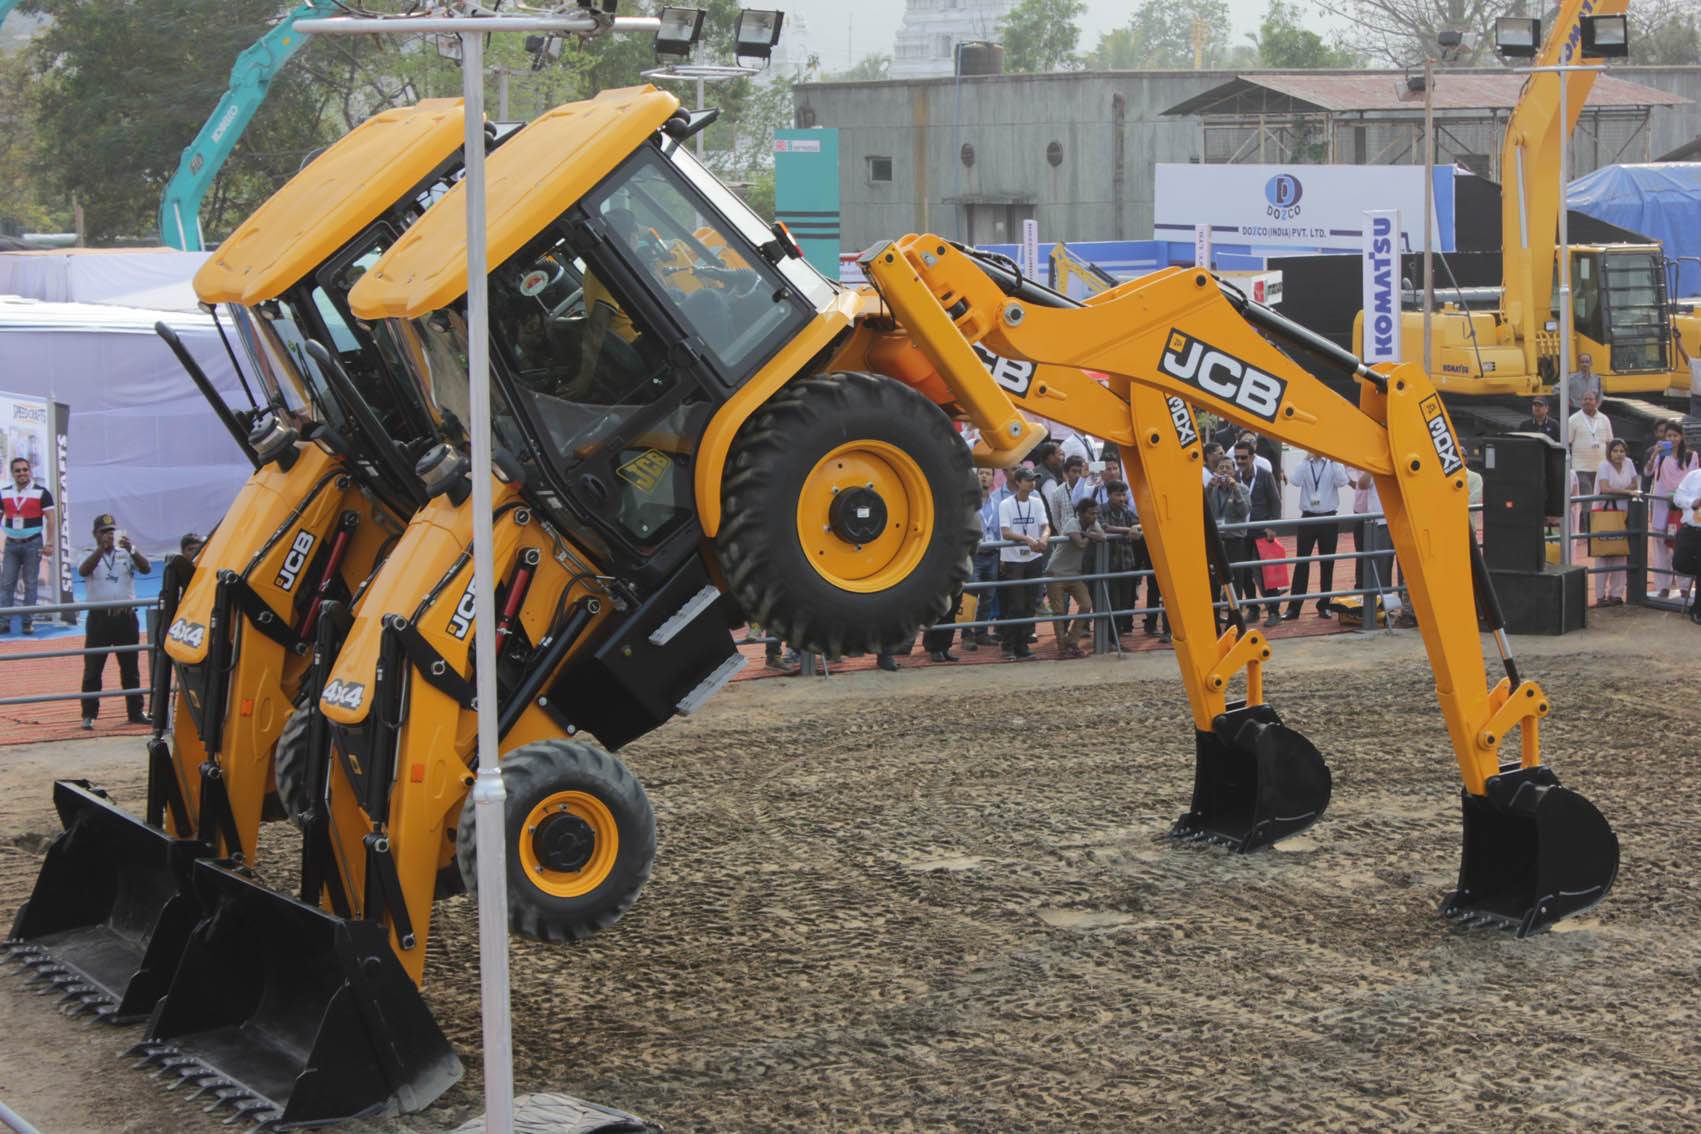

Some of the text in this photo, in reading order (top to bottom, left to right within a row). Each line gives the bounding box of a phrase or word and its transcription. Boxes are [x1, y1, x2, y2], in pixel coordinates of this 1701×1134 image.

[1266, 205, 1301, 220] DOZCO
[1368, 217, 1393, 356] KOMATSU
[1162, 341, 1282, 417] JCB
[623, 451, 668, 490] JCB
[280, 530, 314, 590] JCB
